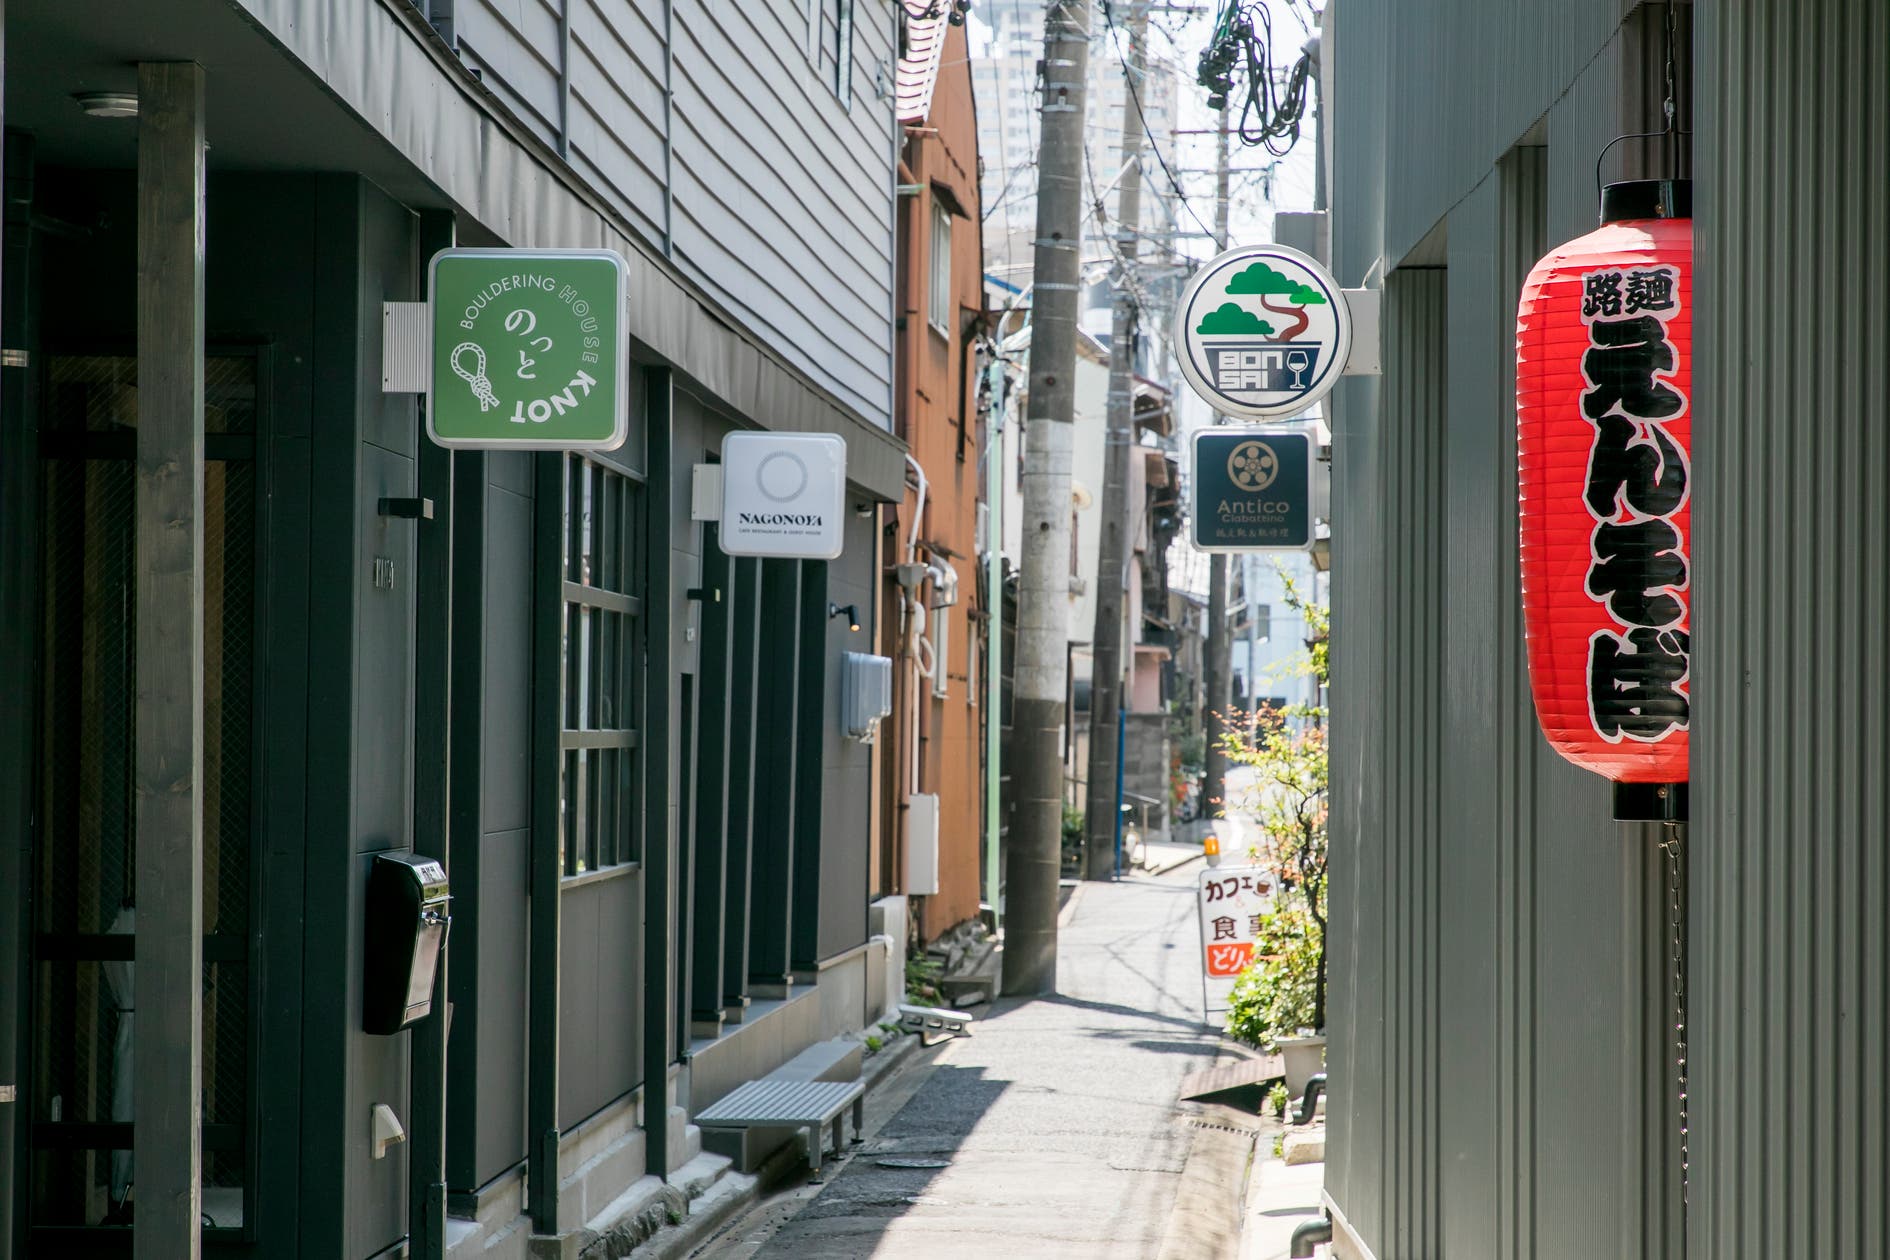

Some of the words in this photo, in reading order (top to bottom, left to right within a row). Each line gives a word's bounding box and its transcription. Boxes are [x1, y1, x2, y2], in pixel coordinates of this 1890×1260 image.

[460, 274, 556, 330] BOULDERING
[558, 284, 600, 364] HOUSE
[504, 308, 553, 379] のっと
[1218, 351, 1283, 370] BON
[1218, 371, 1268, 389] SAI
[510, 369, 597, 424] KNOT
[739, 513, 822, 526] NAGONOYA
[1217, 499, 1290, 514] Antico
[1205, 876, 1253, 902] カフェ
